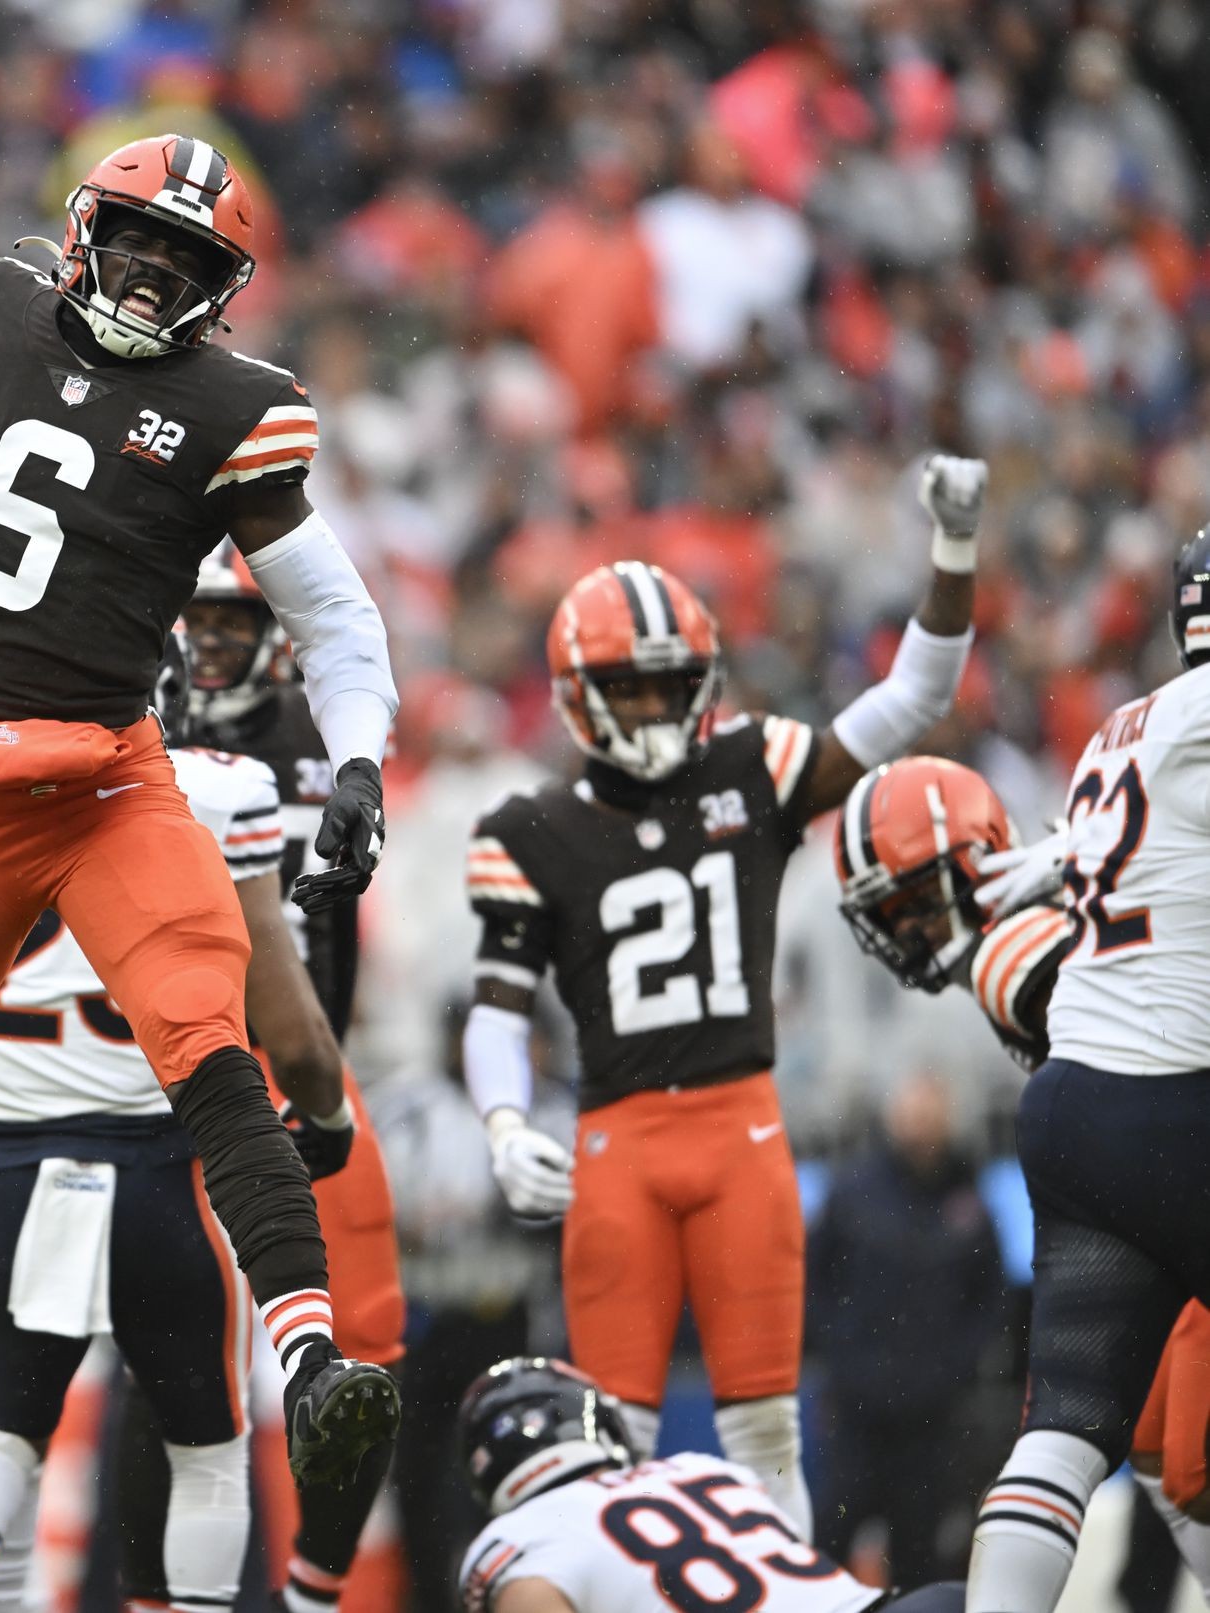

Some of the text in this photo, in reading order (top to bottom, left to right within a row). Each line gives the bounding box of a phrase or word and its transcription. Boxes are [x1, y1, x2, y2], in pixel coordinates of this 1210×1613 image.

[128, 408, 186, 462] 32
[697, 788, 749, 834] 32
[598, 850, 750, 1036] 21
[600, 1473, 848, 1613] 85
